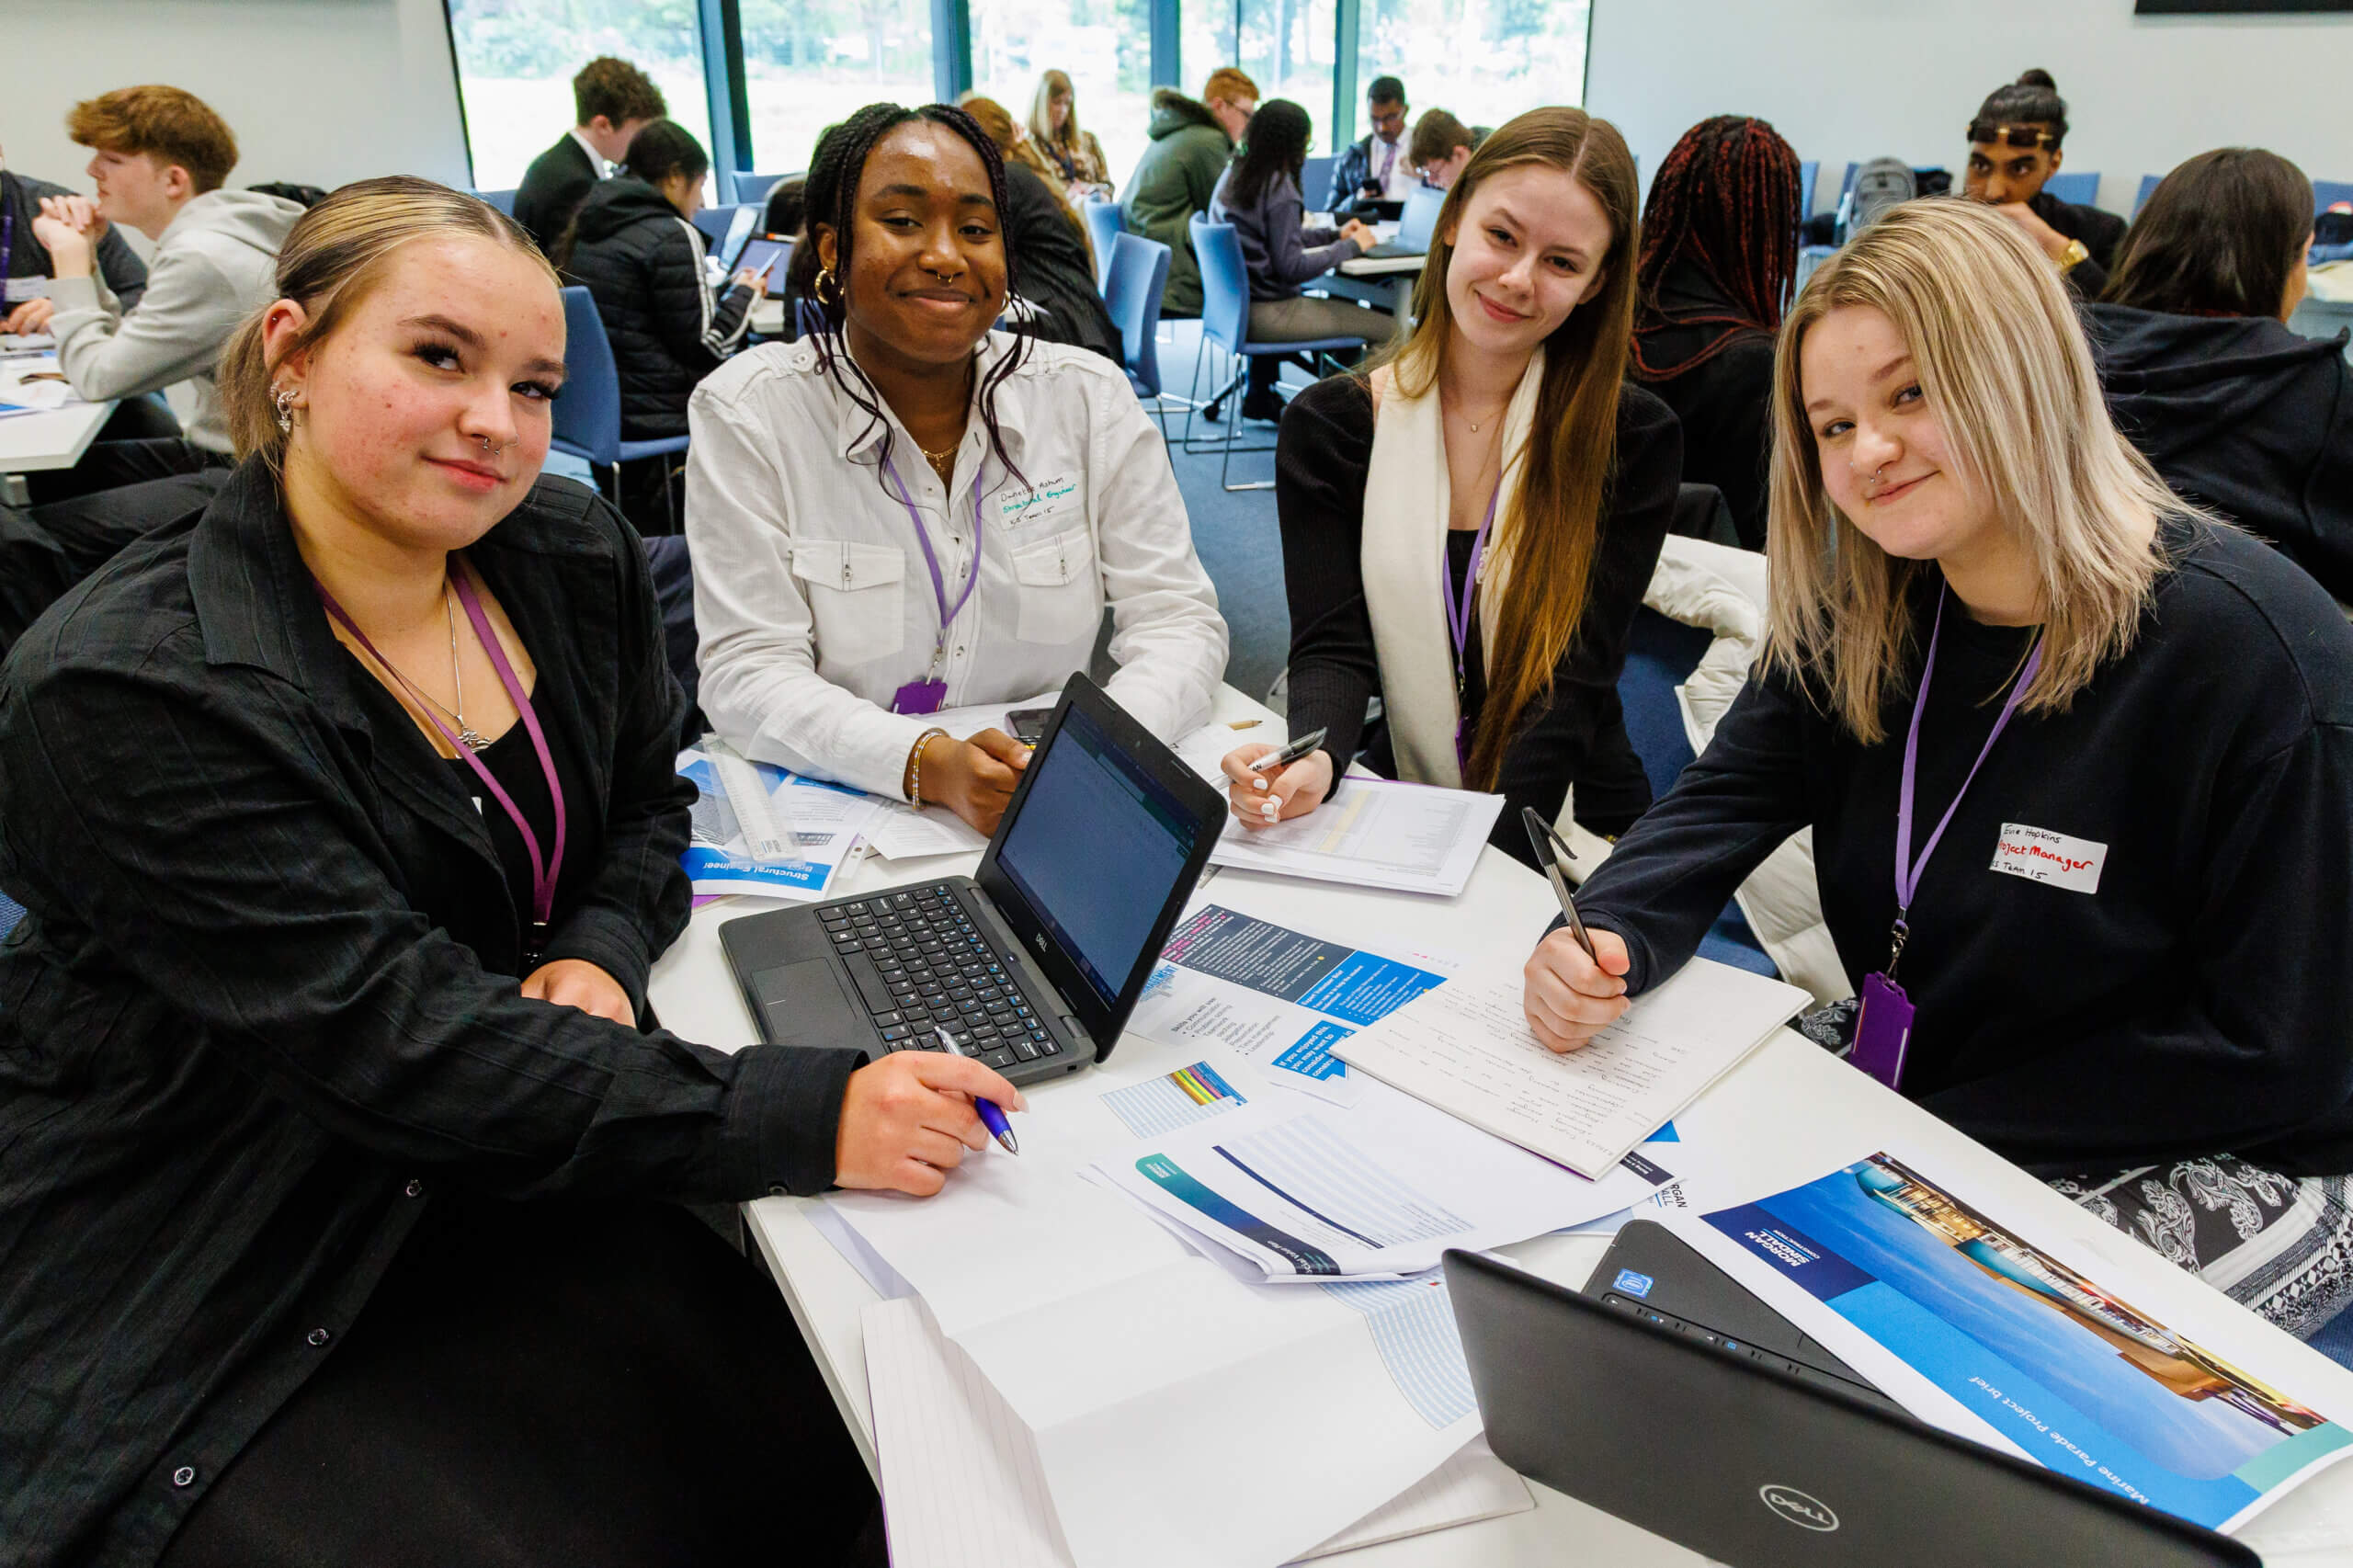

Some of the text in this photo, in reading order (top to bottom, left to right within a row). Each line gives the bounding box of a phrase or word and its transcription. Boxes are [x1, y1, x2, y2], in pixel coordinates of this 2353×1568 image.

[2025, 828, 2061, 844] Hopkins
[2029, 846, 2094, 871] Manager
[754, 867, 810, 881] Structural
[1035, 933, 1048, 952] DELL
[1185, 1014, 1198, 1022] you
[1285, 1052, 1298, 1062] you
[1296, 1035, 1319, 1053] enjoyed
[1290, 1061, 1303, 1070] you
[1301, 1050, 1316, 1061] may
[1313, 1040, 1328, 1051] want
[1302, 1052, 1325, 1073] consider
[1280, 1248, 1300, 1259] Value
[1745, 1231, 1802, 1267] MORGAN
[1760, 1231, 1811, 1264] SINDALL
[1773, 1230, 1821, 1259] CONSTRUCTION
[1967, 1376, 2150, 1505] Marine Parade Project brief
[1769, 1492, 1831, 1525] DELL
